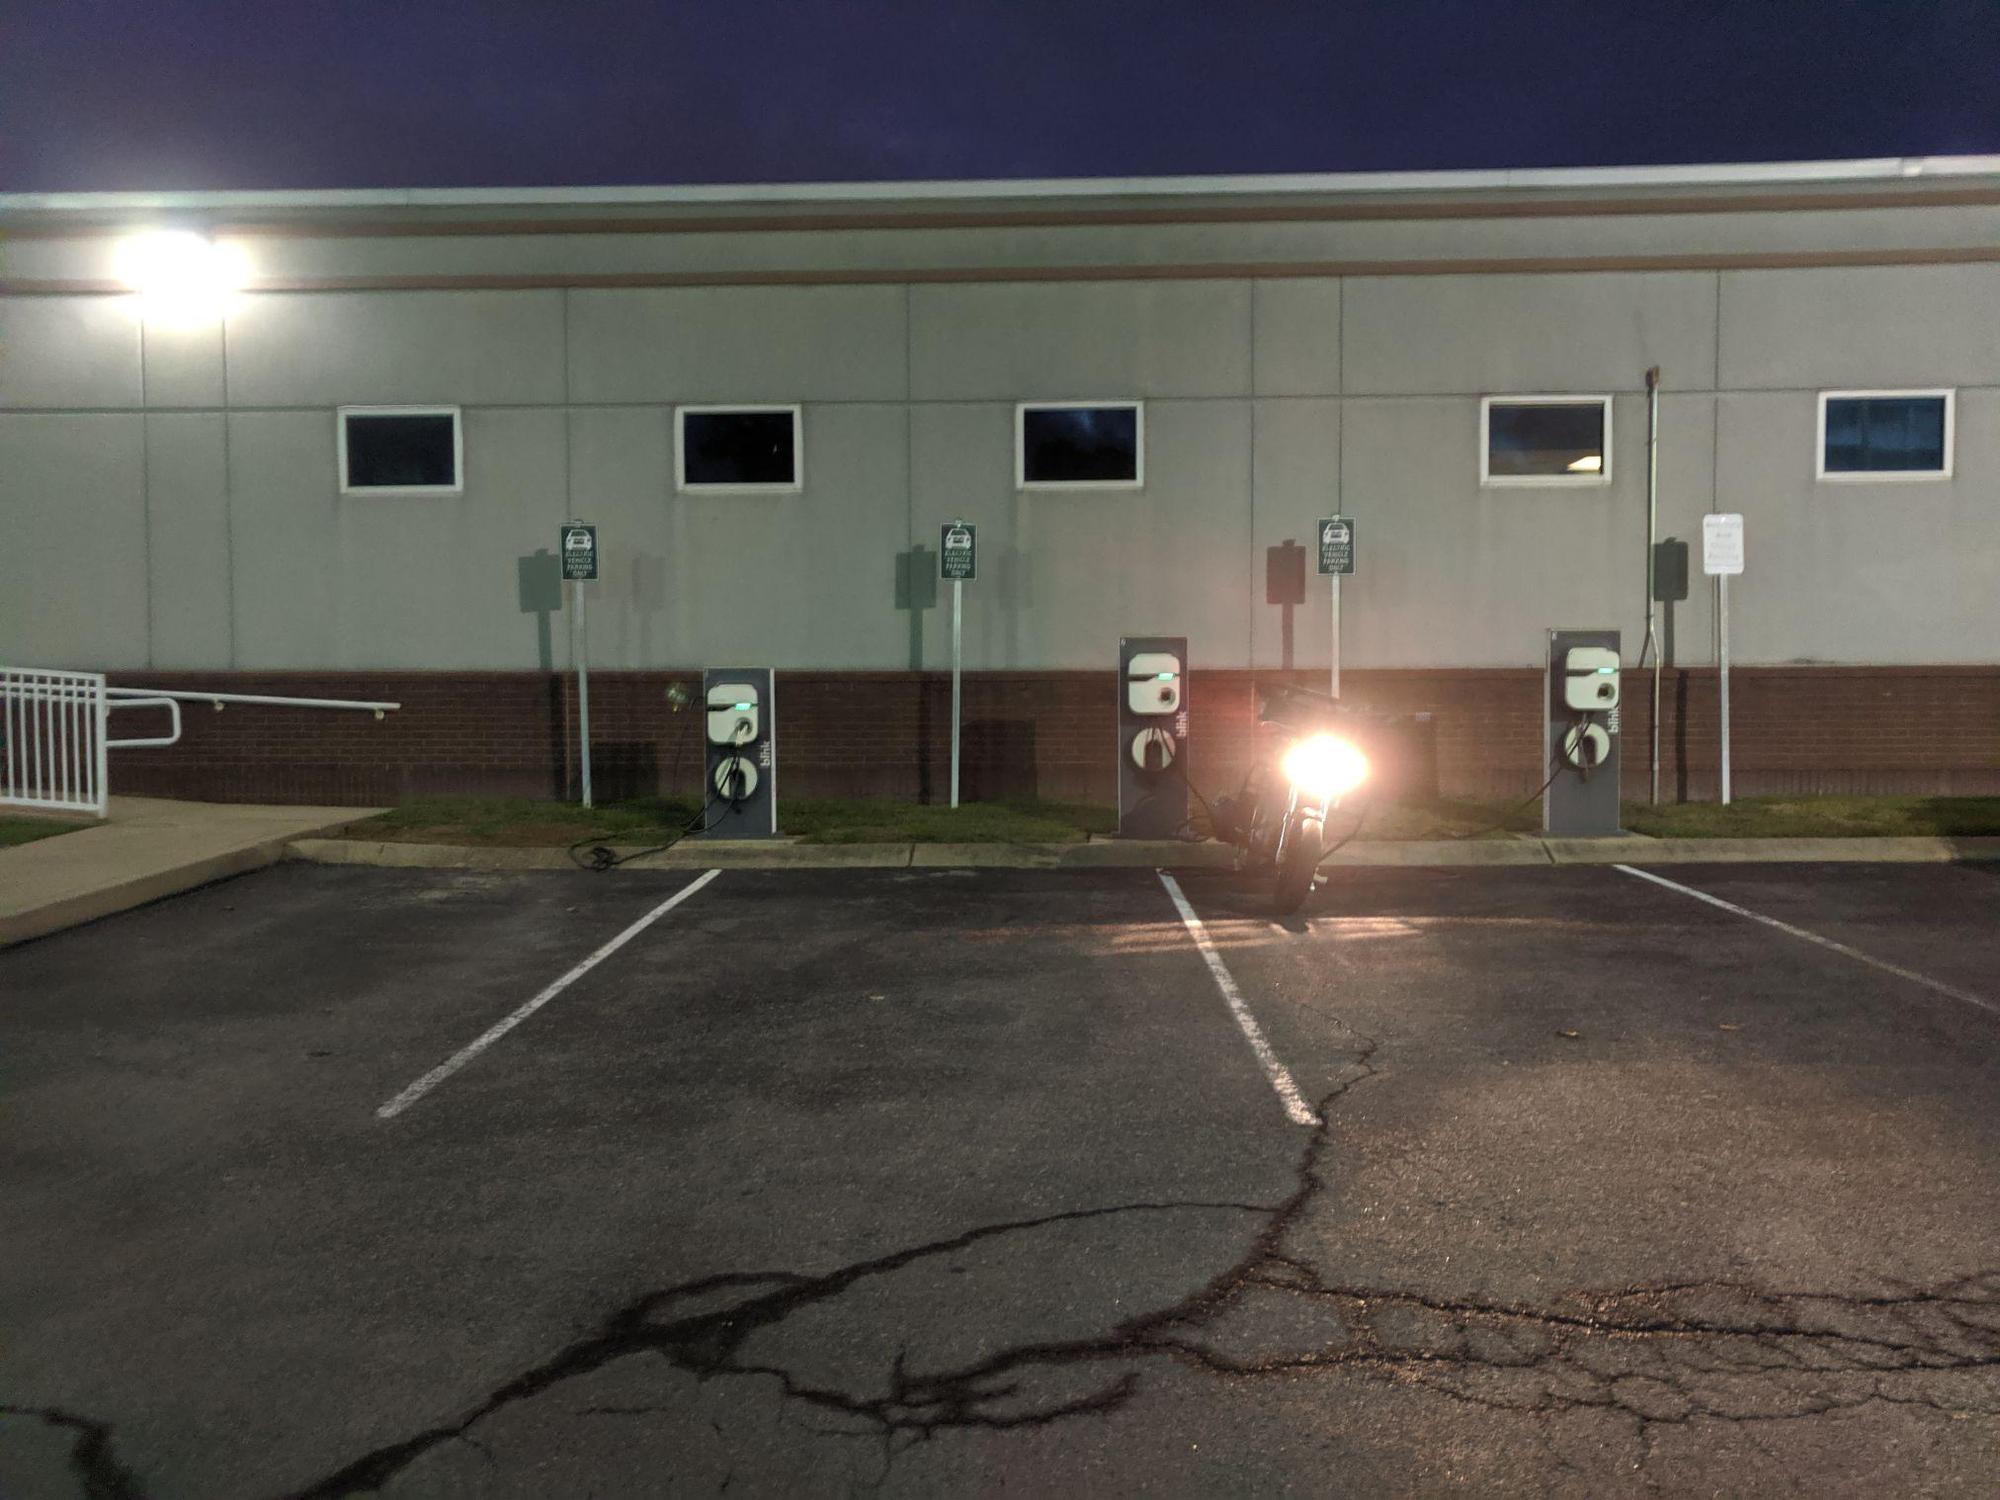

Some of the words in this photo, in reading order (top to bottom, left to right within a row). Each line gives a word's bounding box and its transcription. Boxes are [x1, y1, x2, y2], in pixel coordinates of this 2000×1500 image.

[1176, 711, 1187, 737] blink
[1608, 707, 1619, 733] blink
[760, 741, 771, 767] blink
